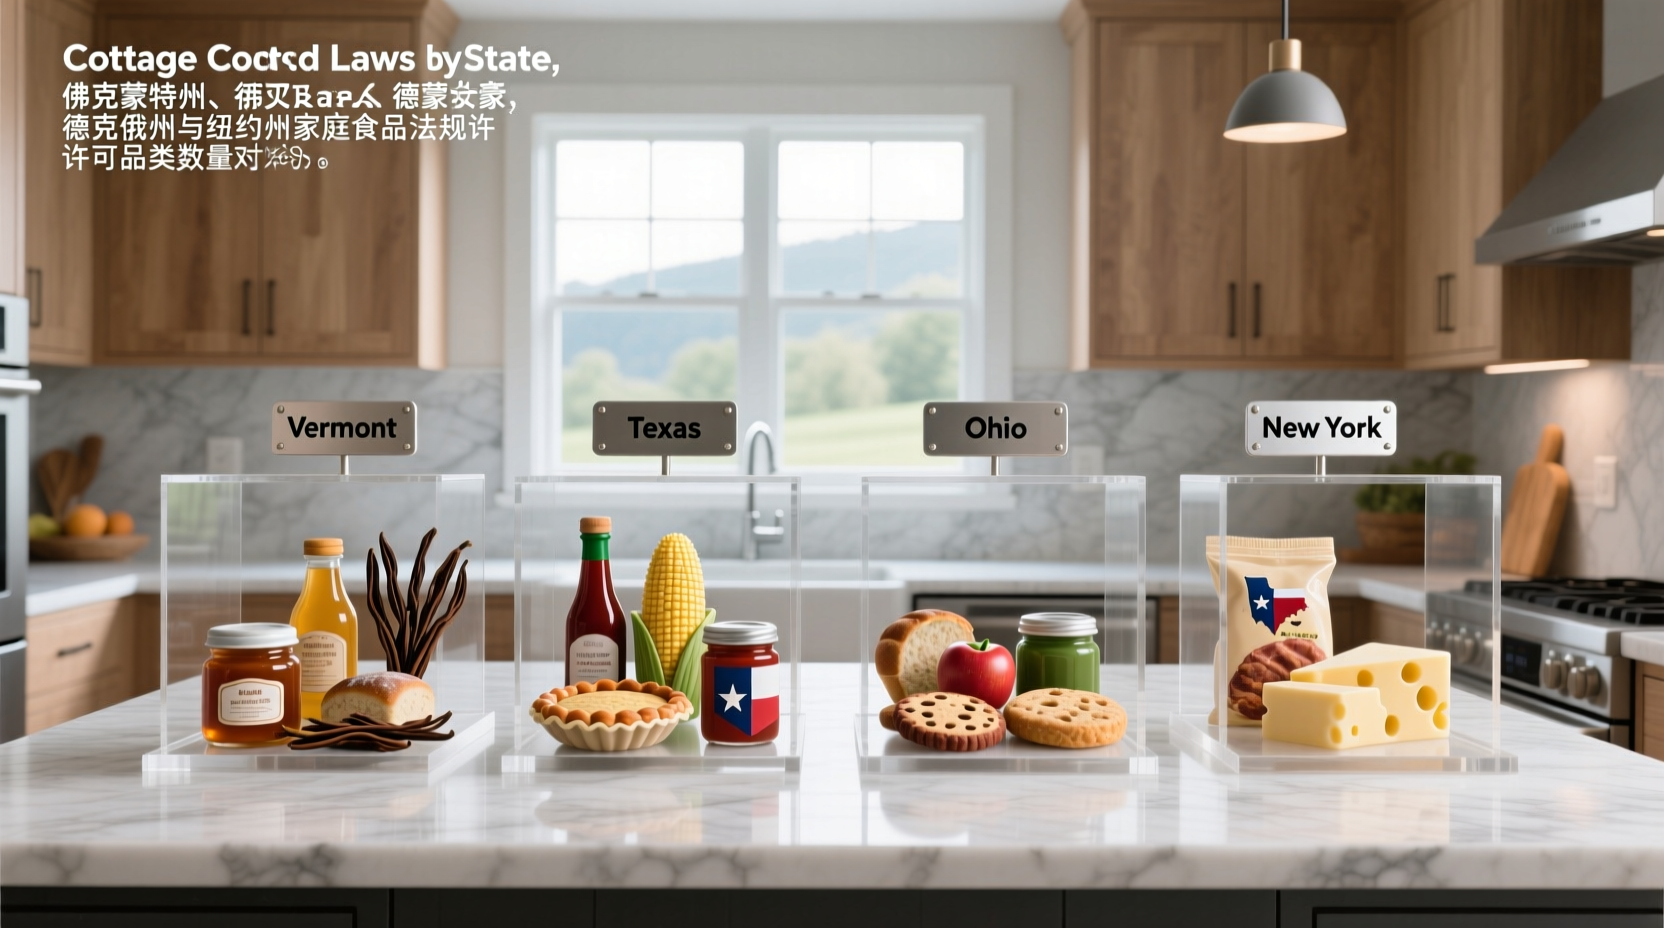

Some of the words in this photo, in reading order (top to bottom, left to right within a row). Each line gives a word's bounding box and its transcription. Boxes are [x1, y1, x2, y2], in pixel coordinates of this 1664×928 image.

[286, 415, 398, 440] Vermont
[627, 415, 702, 440] Texas
[964, 415, 1028, 440] Ohio
[1262, 415, 1320, 439] New
[1325, 415, 1383, 439] York
